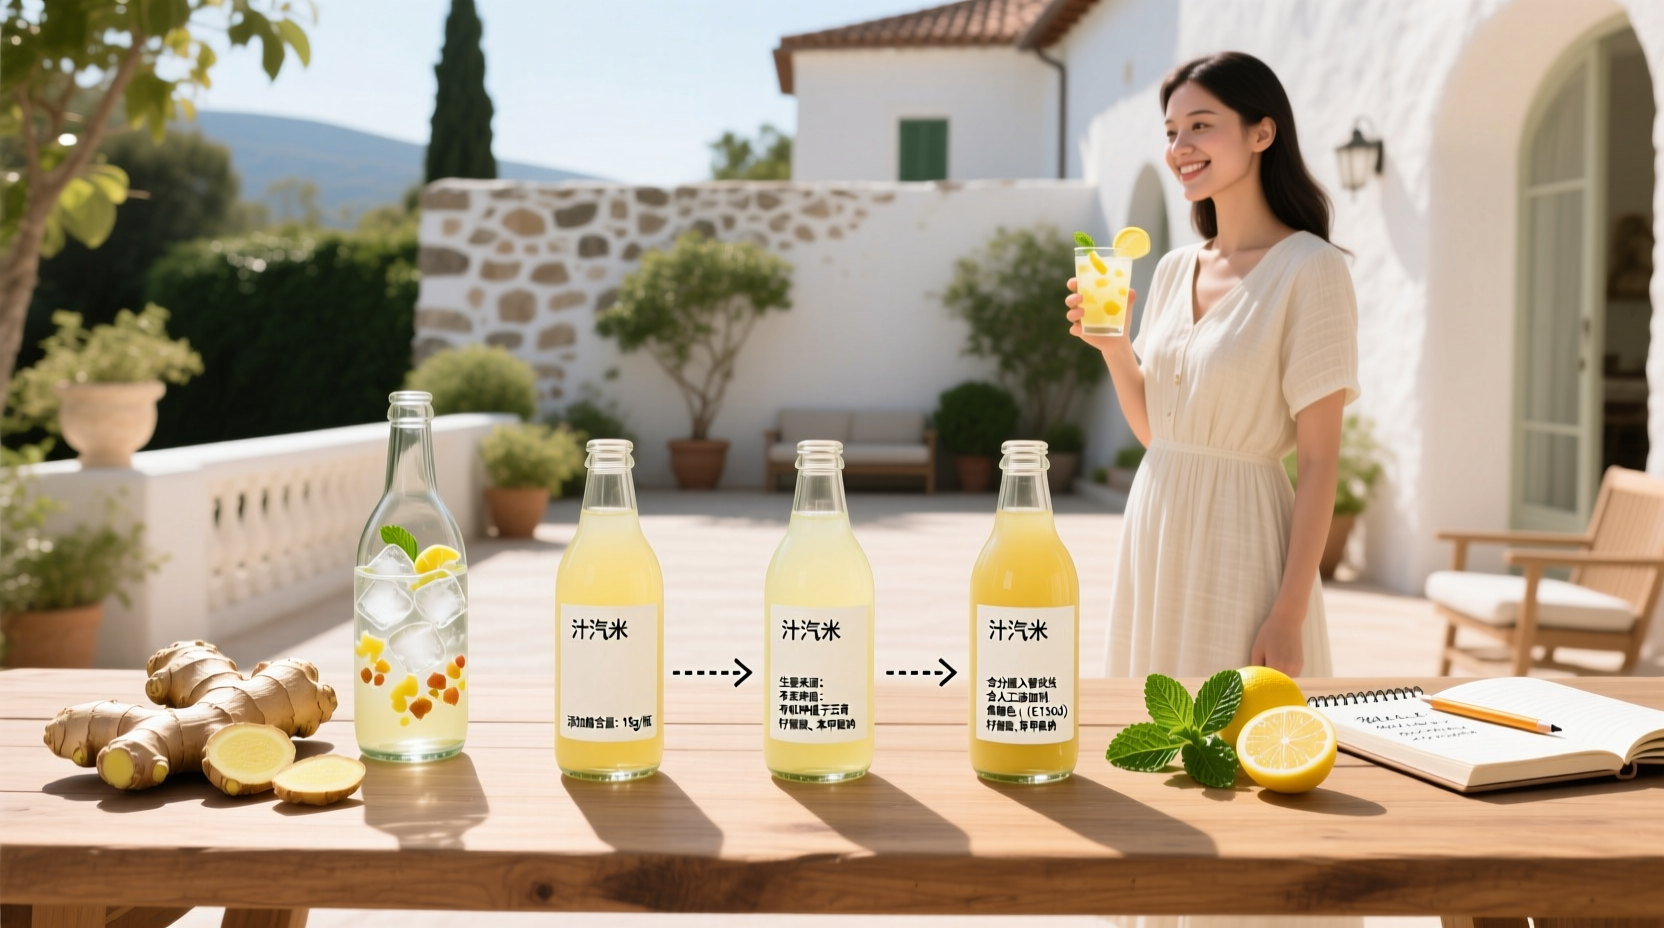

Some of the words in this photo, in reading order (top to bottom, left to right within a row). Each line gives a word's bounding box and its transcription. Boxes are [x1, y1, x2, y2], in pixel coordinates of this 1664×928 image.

[571, 618, 628, 640] 汁汽米
[781, 619, 841, 641] 汁汽米
[989, 618, 1048, 641] 汁汽米
